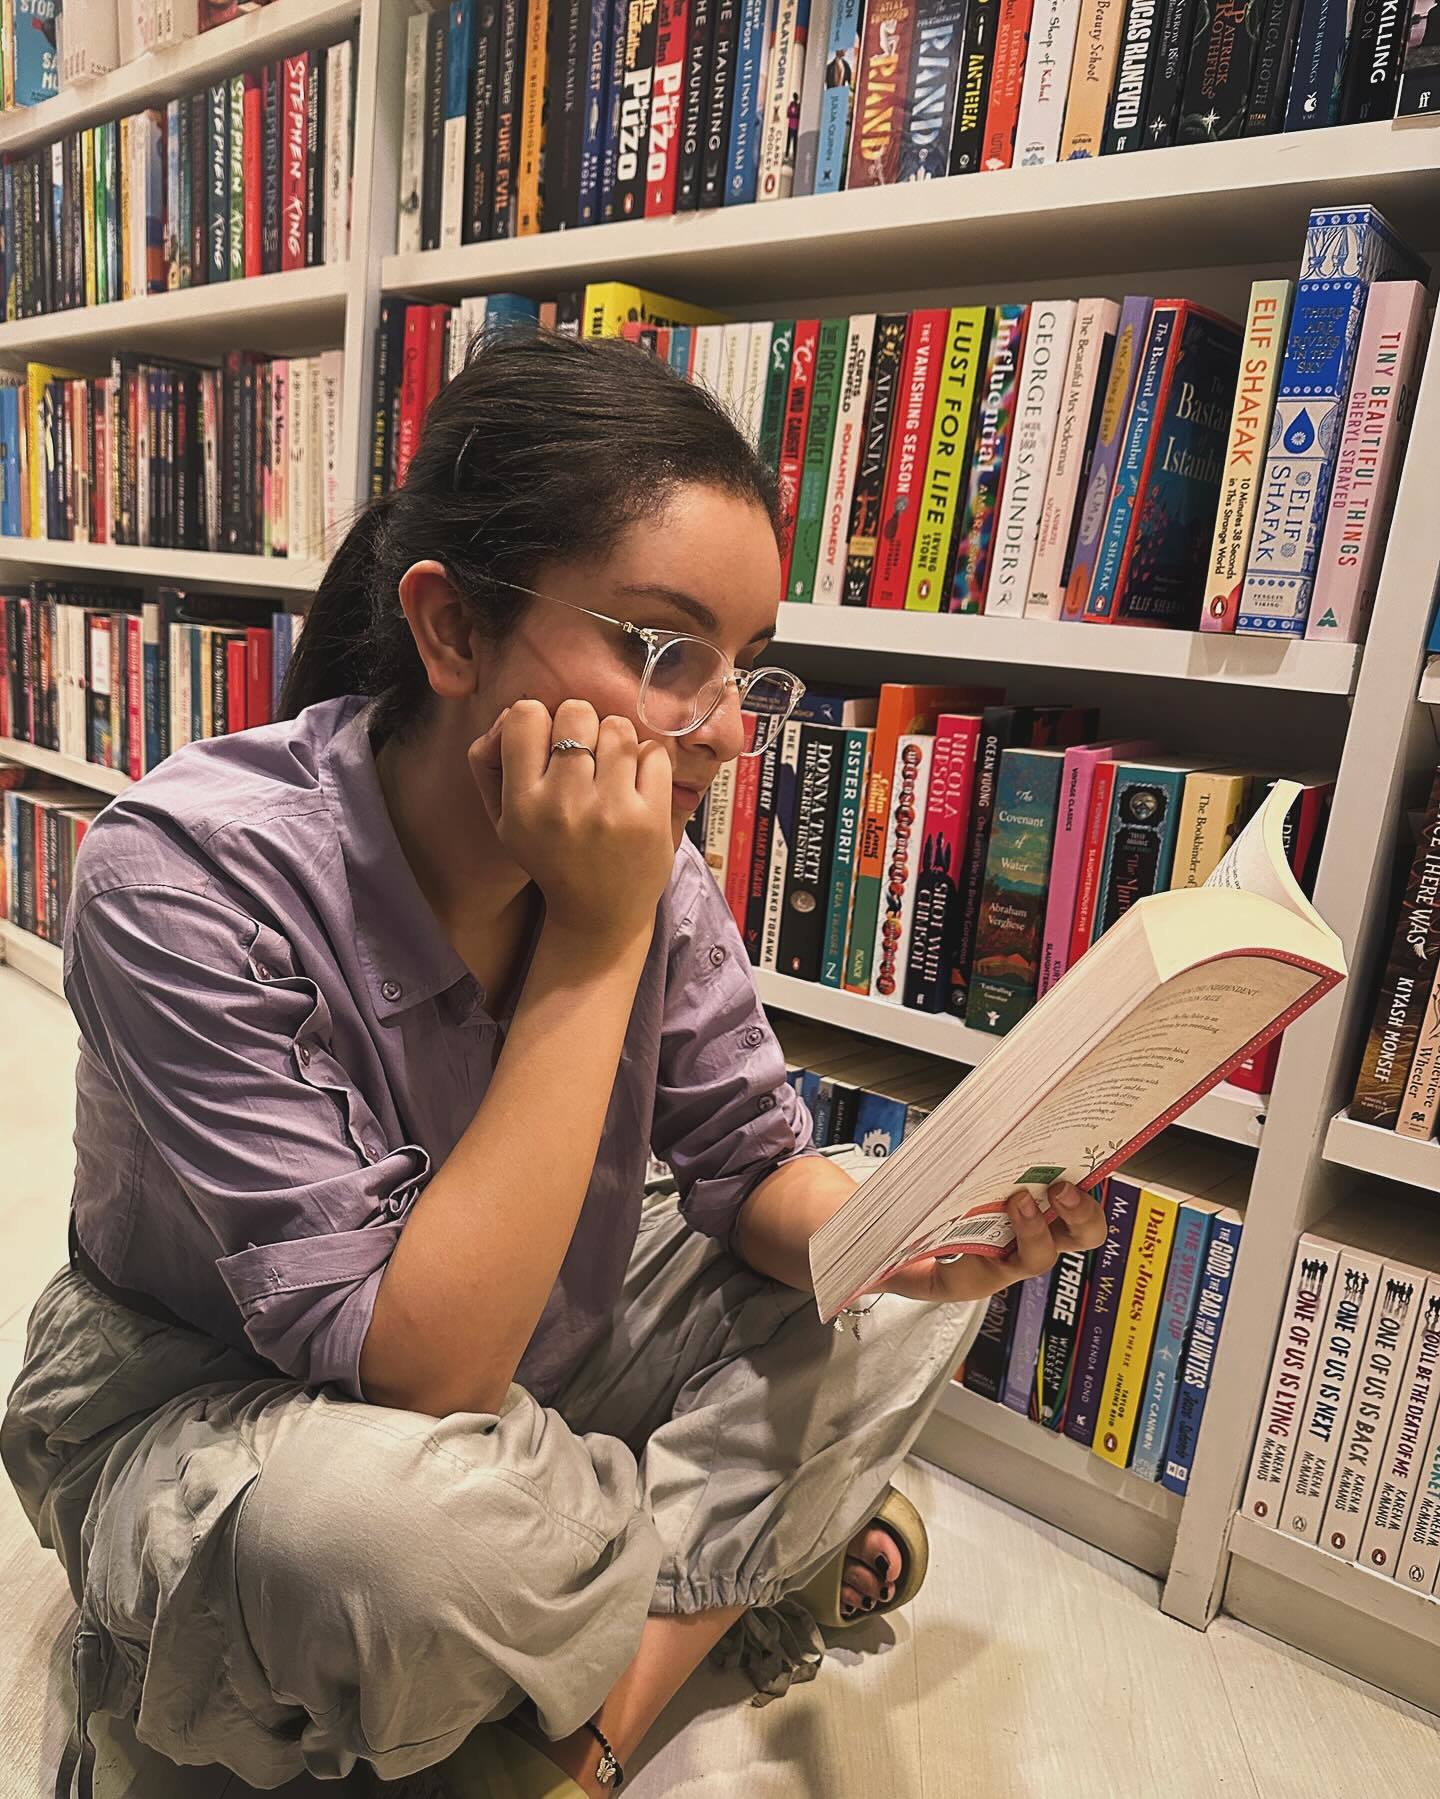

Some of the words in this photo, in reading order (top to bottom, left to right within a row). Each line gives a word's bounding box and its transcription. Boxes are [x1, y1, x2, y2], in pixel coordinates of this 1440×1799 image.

[1089, 1, 1110, 42] Beauty
[1370, 1, 1398, 84] KILLING
[775, 12, 792, 90] PLATFORM
[1086, 44, 1104, 82] School
[684, 46, 704, 155] HAUNTING
[709, 41, 730, 151] HAUNTING
[861, 54, 899, 160] RAND
[910, 24, 954, 145] RAND
[961, 55, 985, 132] ANTHEM
[1038, 69, 1052, 103] Kabul
[1113, 42, 1149, 130] RIJNEVELD
[211, 87, 226, 196] STEPHEN
[230, 80, 244, 192] STEPHEN
[287, 60, 306, 178] STEPHEN
[496, 113, 514, 164] PURE
[495, 168, 510, 214] EVIL
[209, 214, 226, 270] KING
[229, 210, 244, 268] KING
[282, 195, 303, 257] KING
[1080, 314, 1094, 337] The
[1154, 322, 1169, 343] The
[1249, 299, 1277, 349] ELIF
[815, 349, 840, 400] ROSIE
[842, 334, 860, 413] SITTENFELD
[852, 349, 866, 398] CURTIS
[948, 321, 974, 387] LUST
[1025, 312, 1057, 417] GEORGE
[1071, 338, 1090, 388] Beautiful
[1142, 347, 1164, 397] Bastard
[1375, 332, 1402, 377] TINY
[905, 345, 931, 430] VANISHING
[976, 317, 1018, 472] Influential
[1137, 401, 1150, 414] of
[807, 405, 832, 465] PROJECT
[937, 398, 962, 457] FOR
[1230, 360, 1267, 466] SHAFAK
[1345, 392, 1367, 444] CHERYL
[1126, 417, 1148, 470] Istanbul
[1353, 386, 1391, 489] BEAUTIFUL
[834, 423, 853, 500] ROMANTIC
[896, 434, 917, 494] SEASON
[1240, 478, 1251, 489] 10
[1331, 449, 1355, 510] STRAYED
[927, 470, 951, 525] LIFE
[998, 453, 1034, 585] SAUNDERS
[1224, 489, 1237, 507] This
[1232, 492, 1248, 528] Minutes
[1255, 464, 1291, 562] SHAFAK
[1283, 489, 1310, 541] ELIF
[826, 504, 841, 566] COMEDY
[1111, 508, 1126, 537] ELIF
[1218, 509, 1232, 545] Strange
[1231, 530, 1243, 541] 38
[1338, 499, 1370, 567] THINGS
[917, 534, 931, 569] STONE
[927, 532, 942, 572] IRVING
[1099, 541, 1119, 591] SHAFAK
[1214, 546, 1228, 576] World
[1226, 544, 1242, 581] Seconds
[761, 750, 777, 789] MASTER
[843, 740, 862, 800] SISTER
[927, 737, 951, 813] UPSON
[943, 733, 969, 819] NICOLA
[981, 736, 998, 770] OCEAN
[759, 790, 772, 810] KEY
[799, 768, 816, 823] SECRET
[812, 743, 834, 814] DONNA
[978, 772, 993, 807] VUONG
[999, 810, 1045, 828] Covenant
[1065, 799, 1076, 832] CLASSICS
[1196, 793, 1212, 815] The
[792, 824, 812, 881] HISTORY
[804, 820, 824, 884] TARTT
[837, 807, 855, 864] SPIRIT
[1188, 817, 1207, 872] Bookbinder
[769, 866, 782, 912] MASAKO
[1416, 853, 1439, 904] THERE
[930, 882, 949, 927] SHOT
[989, 902, 1027, 918] Abraham
[1406, 908, 1431, 944] WAS
[764, 917, 779, 963] TOGAWA
[909, 889, 932, 970] CRIMSON
[923, 936, 942, 982] WITH
[1388, 977, 1415, 1027] KIYASH
[1373, 1030, 1401, 1083] MONSEF
[1407, 1046, 1433, 1099] Wheeler
[1111, 1196, 1129, 1220] Mr.
[1101, 1238, 1119, 1268] Mrs.
[1139, 1207, 1167, 1263] Daisy
[1183, 1221, 1202, 1249] THE
[1218, 1227, 1231, 1241] THE
[1206, 1239, 1235, 1277] GOOD,
[1094, 1275, 1115, 1314] Witch
[1130, 1263, 1157, 1322] Jones
[1171, 1254, 1197, 1314] SWITCH
[1197, 1289, 1225, 1318] BAD,
[1209, 1277, 1221, 1291] THE
[1294, 1290, 1319, 1322] ONE
[1167, 1317, 1186, 1340] UP
[1193, 1317, 1207, 1331] THE
[1204, 1320, 1217, 1336] AND
[1289, 1326, 1310, 1346] OF
[1333, 1301, 1359, 1334] ONE
[1374, 1317, 1400, 1351] ONE
[1043, 1335, 1059, 1383] HUSSEY
[1051, 1336, 1069, 1391] WILLIAM
[1087, 1326, 1102, 1370] GWENDA
[1183, 1331, 1214, 1389] AUNTIES
[1283, 1348, 1305, 1370] US
[1329, 1336, 1351, 1357] OF
[1369, 1353, 1392, 1375] OF
[1418, 1329, 1440, 1363] YOU'LL
[1081, 1374, 1094, 1403] BOND
[1154, 1371, 1167, 1401] KATY
[1279, 1373, 1301, 1387] IS
[1320, 1384, 1342, 1401] IS
[1324, 1359, 1347, 1381] US
[1363, 1376, 1387, 1398] US
[1410, 1383, 1429, 1403] THE
[1416, 1366, 1432, 1382] BE
[1117, 1389, 1129, 1418] TAYLOR
[1142, 1403, 1161, 1450] CANNON
[1267, 1391, 1296, 1437] LYING
[1308, 1402, 1337, 1443] NEXT
[1360, 1401, 1381, 1419] IS
[1400, 1404, 1424, 1442] DEATH
[1256, 1437, 1276, 1481] McMANUS
[1271, 1443, 1288, 1475] KAREN
[1348, 1420, 1376, 1466] BACK
[1398, 1443, 1416, 1460] OF
[1295, 1451, 1315, 1495] McMANUS
[1311, 1457, 1327, 1489] KAREN
[1334, 1467, 1355, 1511] McMANUS
[1349, 1473, 1366, 1505] KAREN
[1392, 1459, 1411, 1479] ME
[1374, 1482, 1395, 1528] McMANUS
[1391, 1489, 1408, 1522] KAREN
[1412, 1497, 1434, 1544] McMANUS
